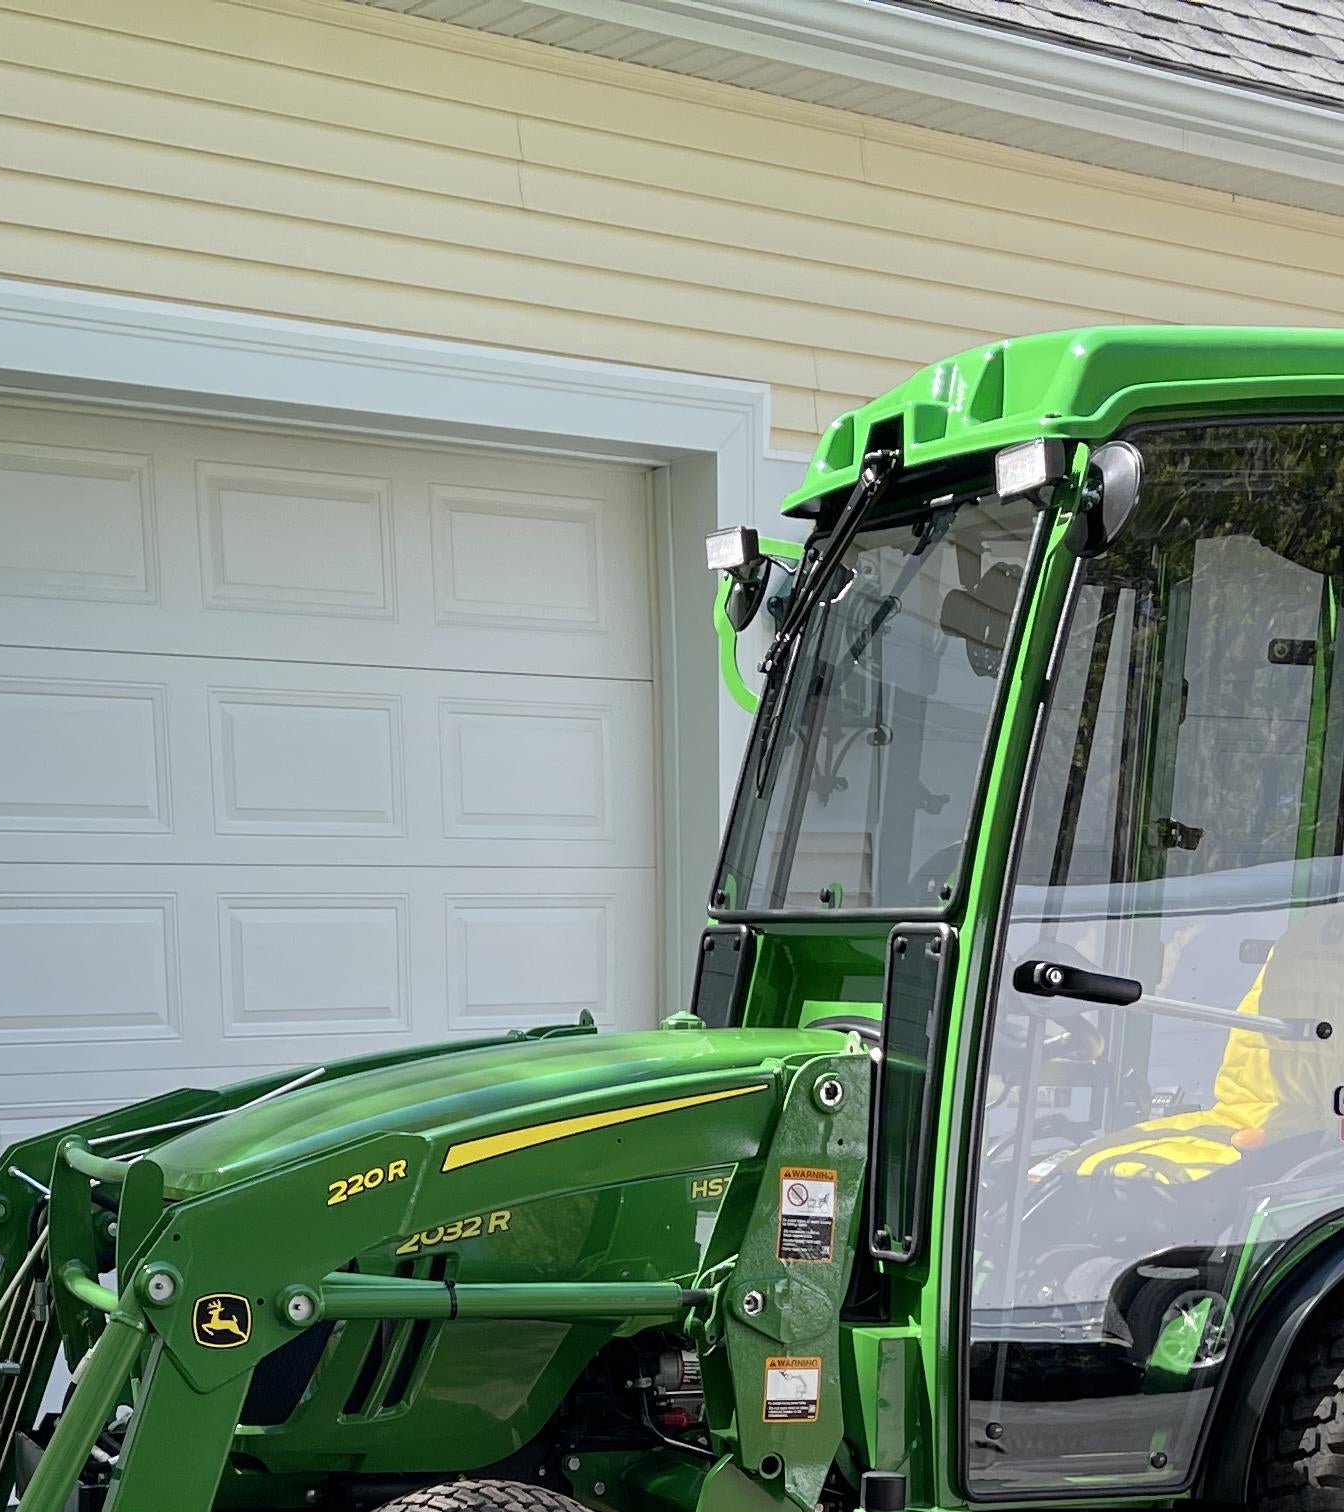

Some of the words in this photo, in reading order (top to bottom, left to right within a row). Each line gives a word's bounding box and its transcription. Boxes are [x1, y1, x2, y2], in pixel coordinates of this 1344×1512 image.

[327, 1167, 385, 1206] 220
[388, 1158, 408, 1182] R
[792, 1169, 834, 1180] WARNING
[395, 1215, 483, 1256] 2032
[488, 1209, 512, 1234] R
[777, 1359, 818, 1367] WARNING
